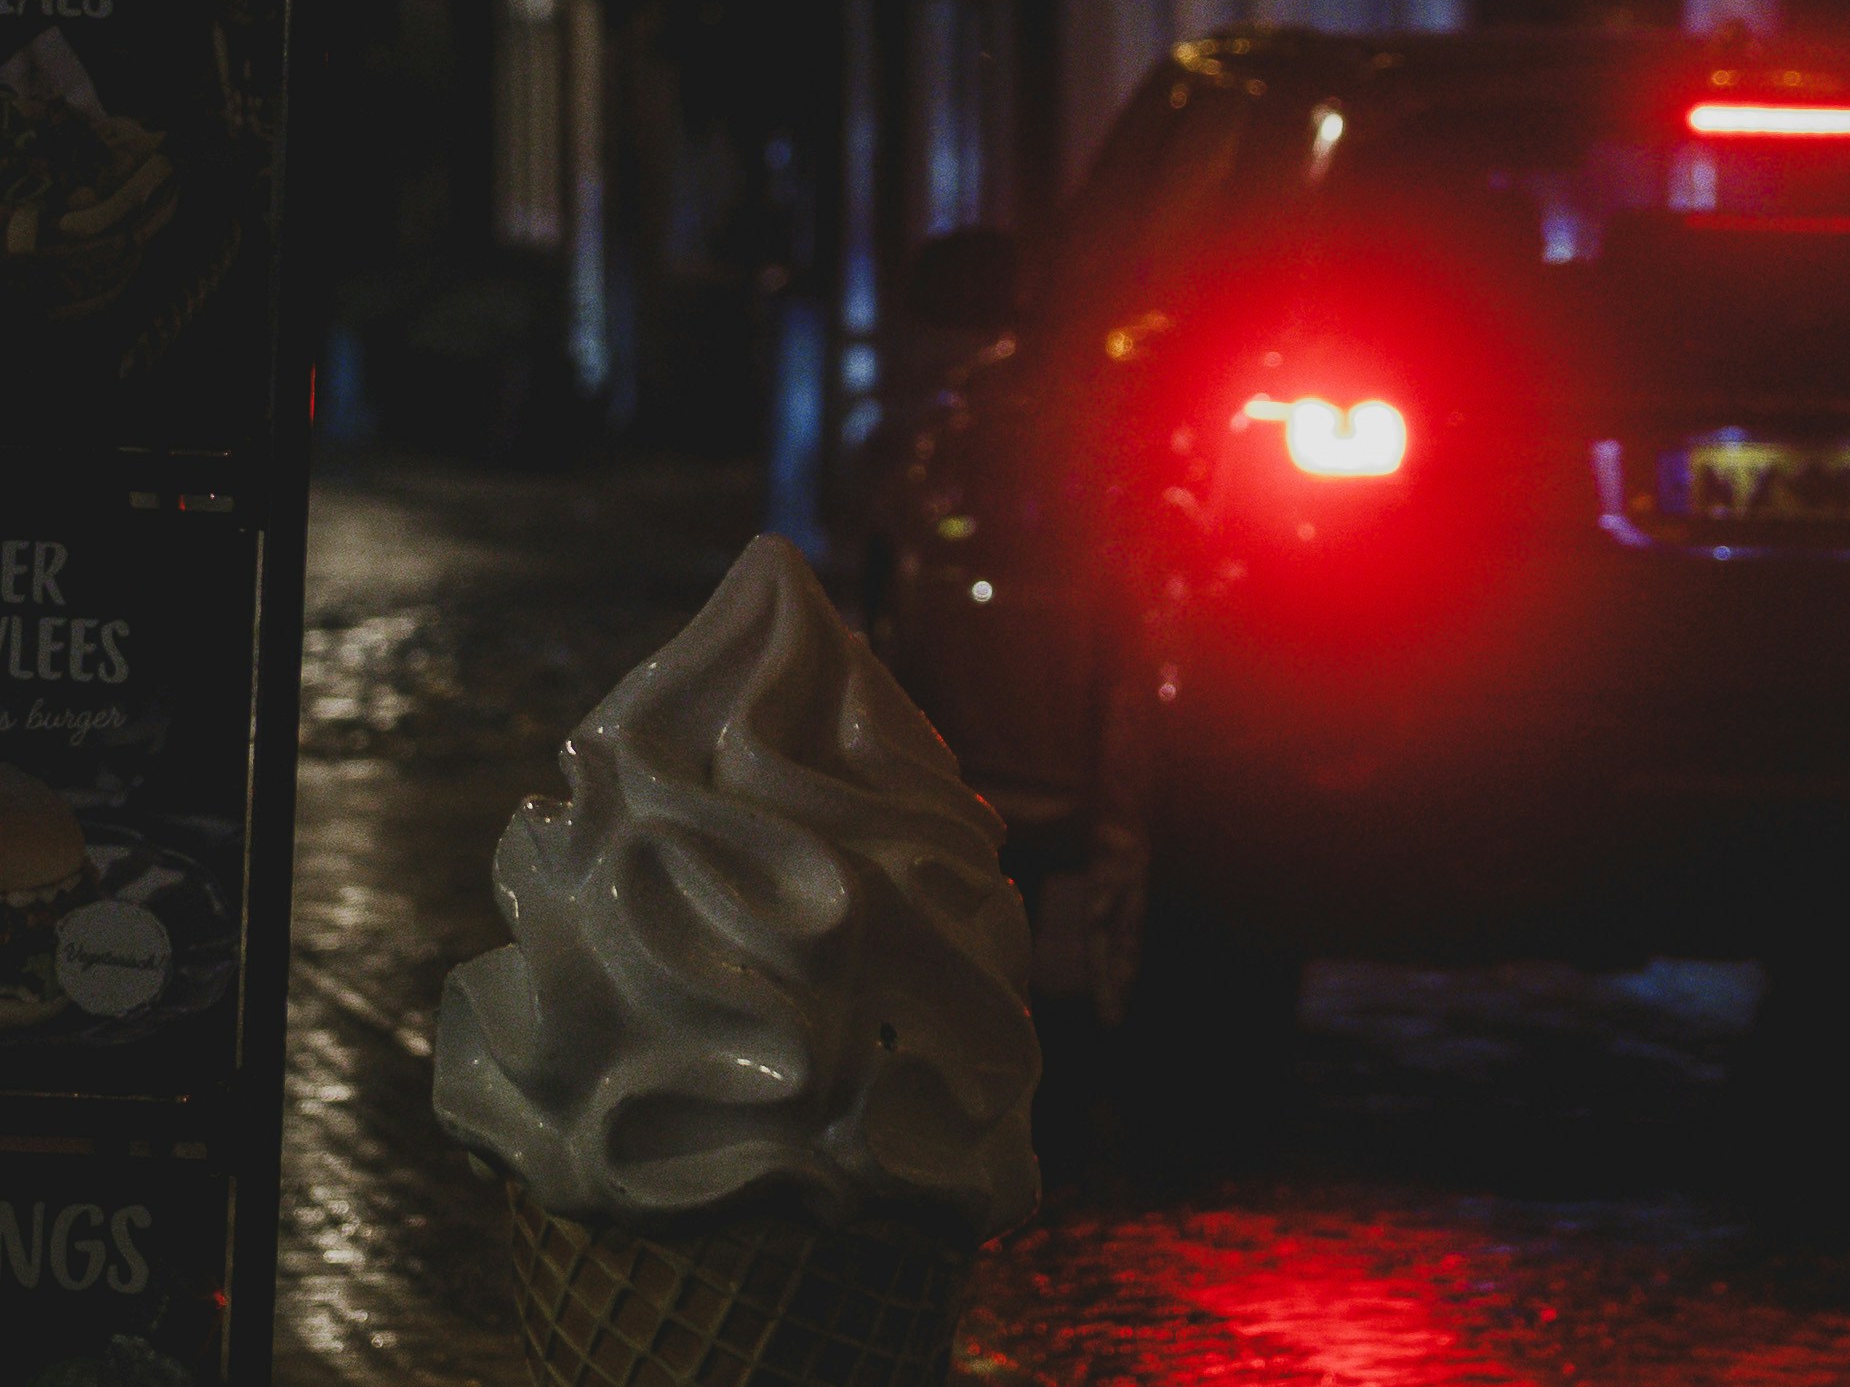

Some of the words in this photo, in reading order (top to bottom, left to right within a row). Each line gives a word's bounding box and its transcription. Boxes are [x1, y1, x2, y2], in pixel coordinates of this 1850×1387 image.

[0, 538, 69, 607] ER
[0, 614, 131, 685] LEES
[23, 695, 127, 748] burger
